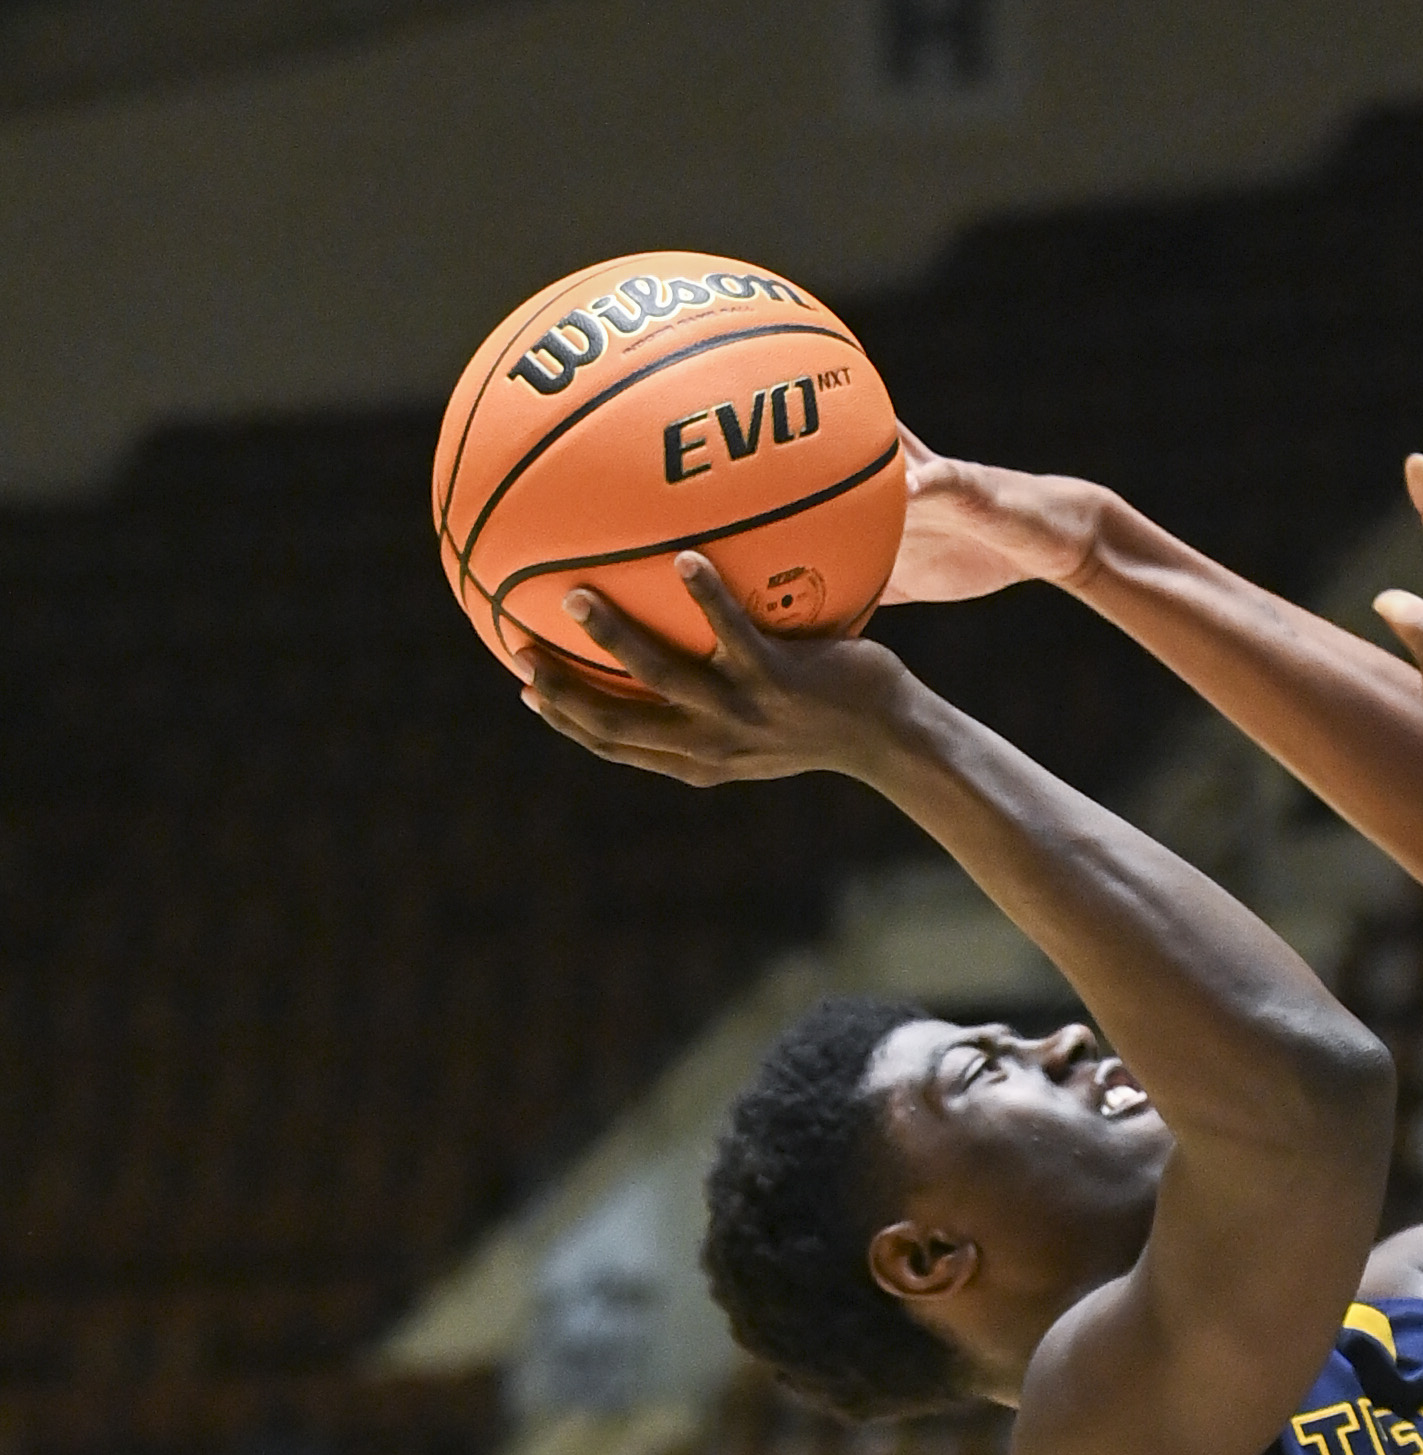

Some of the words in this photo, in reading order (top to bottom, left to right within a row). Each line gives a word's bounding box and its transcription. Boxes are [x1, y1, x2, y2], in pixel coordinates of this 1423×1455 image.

[506, 271, 820, 396] Wilson
[662, 373, 822, 485] EVO
[816, 366, 851, 392] NXT
